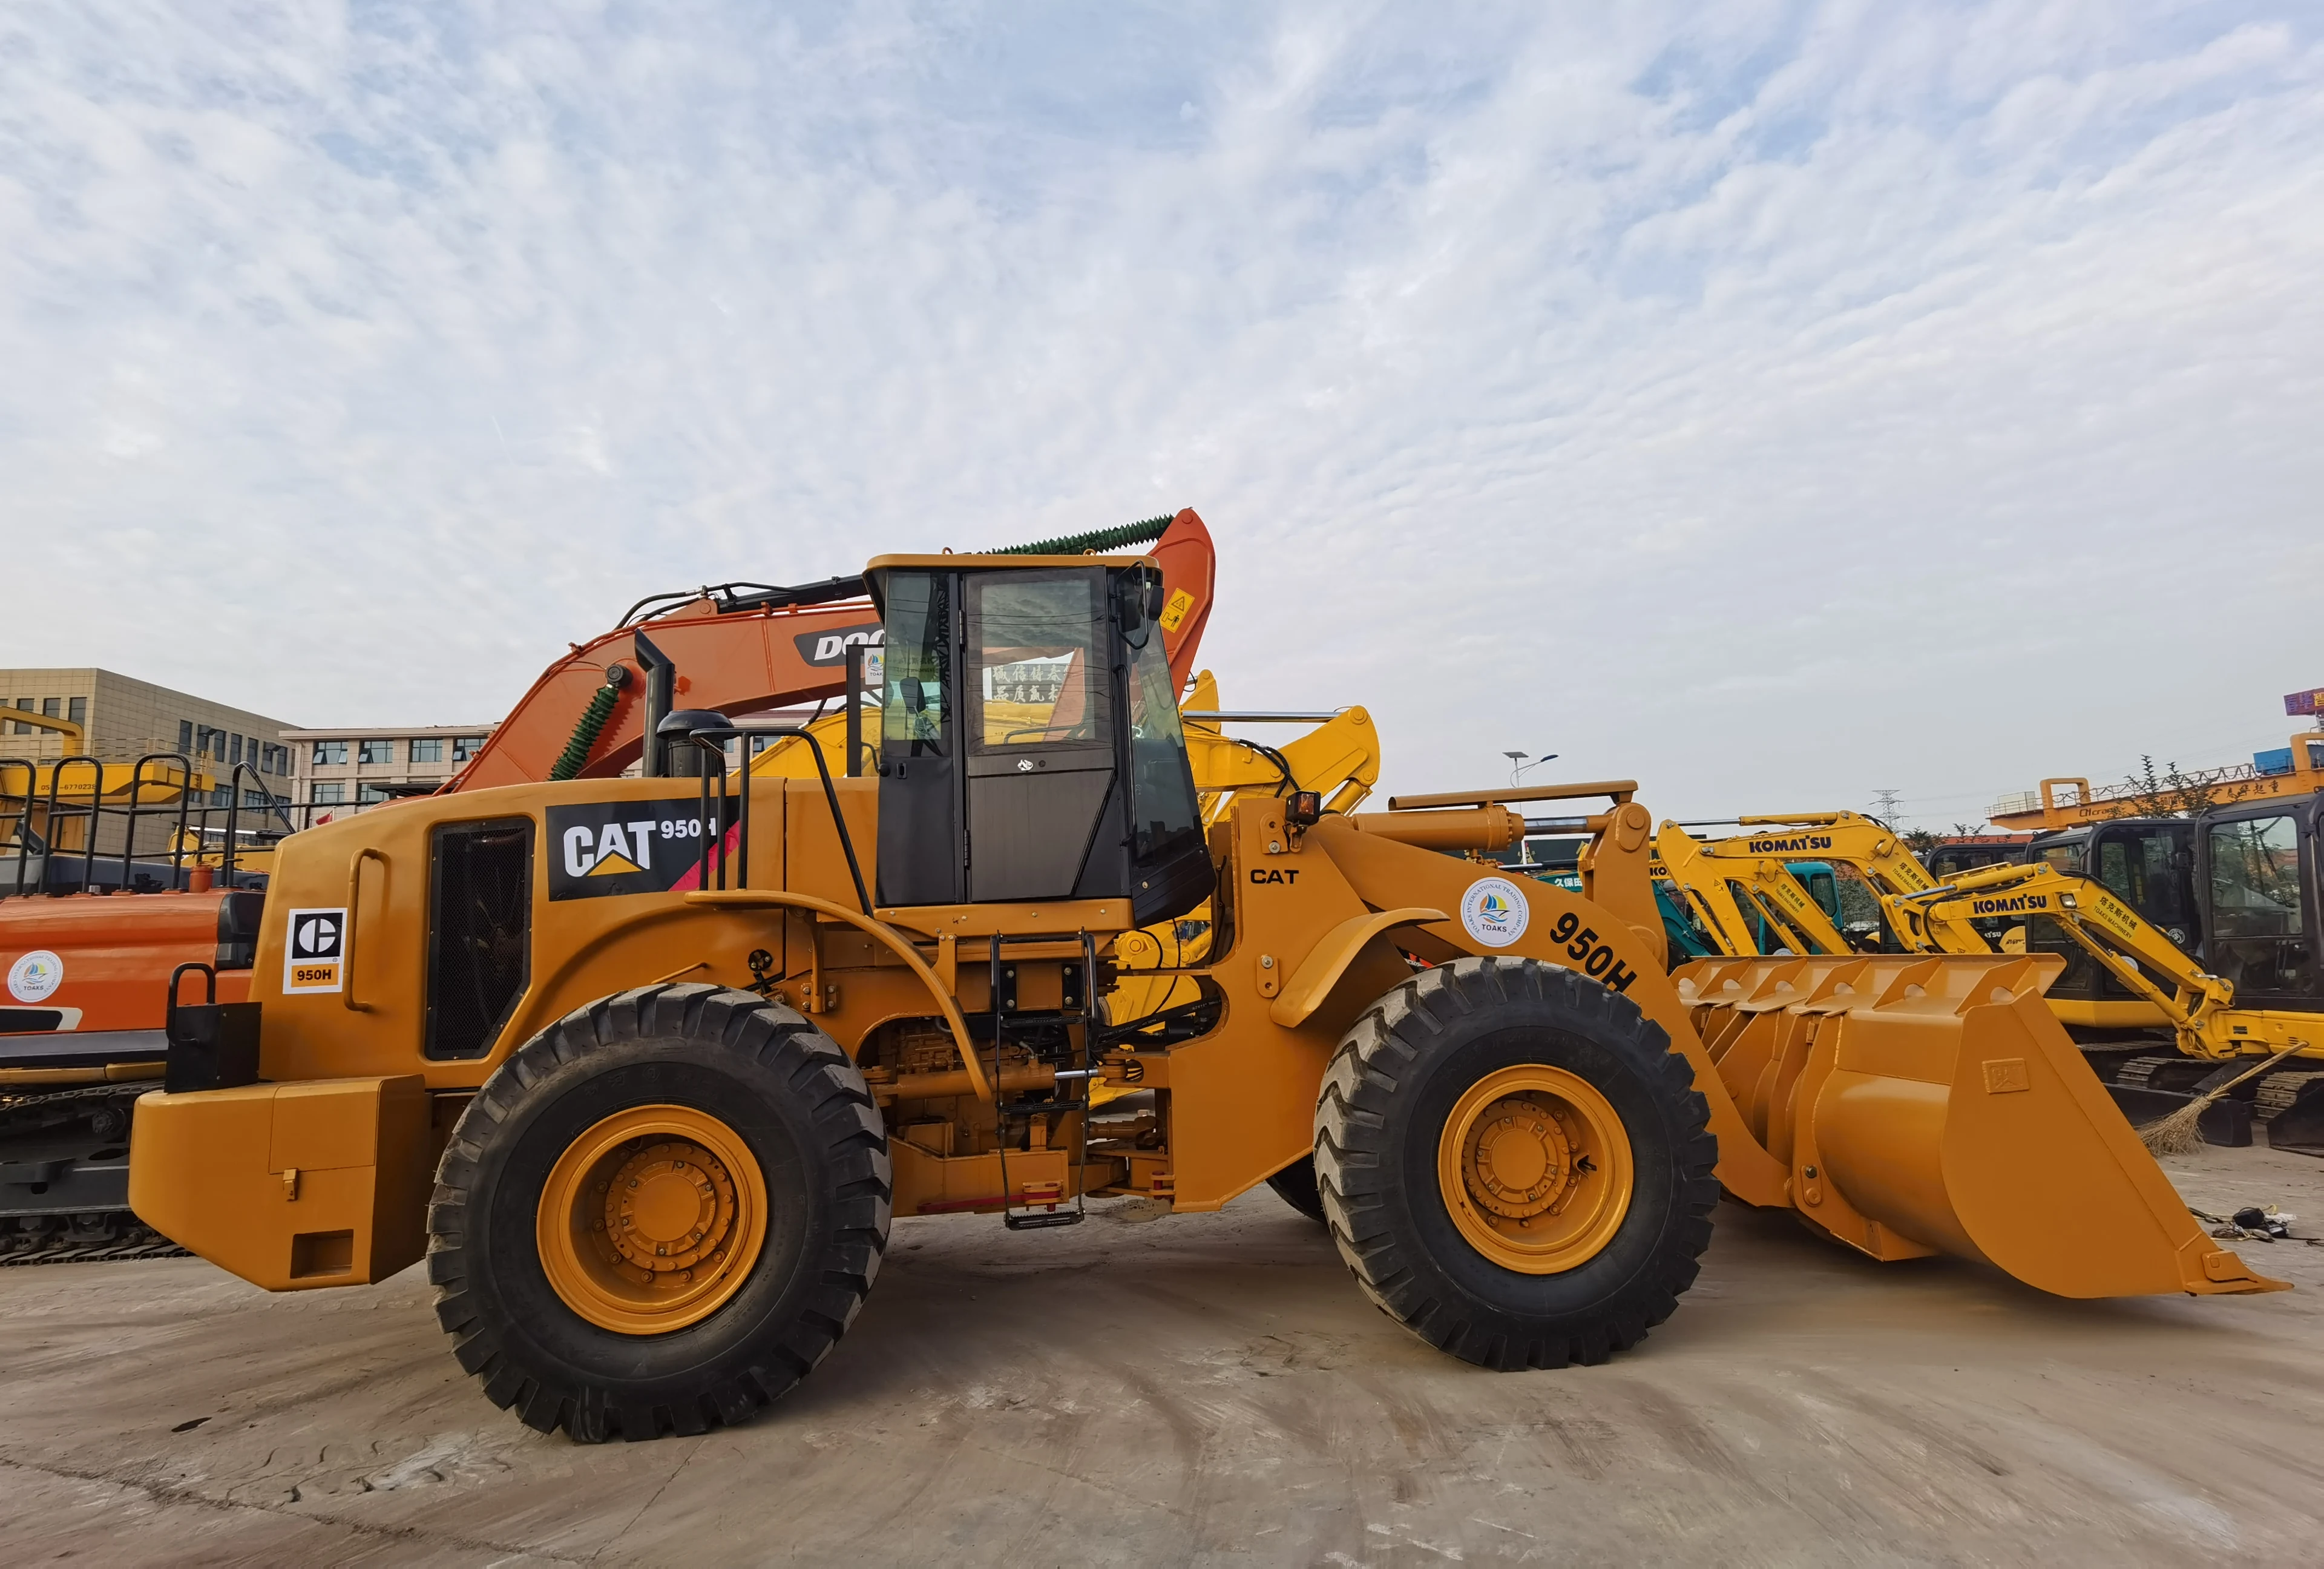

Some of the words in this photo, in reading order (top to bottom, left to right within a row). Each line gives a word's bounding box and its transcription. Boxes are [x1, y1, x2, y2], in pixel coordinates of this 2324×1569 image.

[563, 820, 656, 877] CAT
[1749, 835, 1831, 853] KOMATSU
[1250, 869, 1299, 884] CAT
[1650, 866, 1670, 876] KO
[1892, 868, 1904, 880] TOAKS
[1899, 862, 1929, 890] 塔克斯机械
[1554, 877, 1583, 887] 久保田
[1467, 884, 1502, 913] INTERNATIONAL
[1503, 886, 1523, 909] TRADING
[1973, 893, 2047, 914] KOMATSU
[1508, 910, 1523, 937] COMPANY
[2093, 906, 2108, 920] TOAKS
[2107, 917, 2132, 939] MACHINERY
[2099, 896, 2137, 930] 塔克斯机械
[1467, 914, 1480, 934] TOAKS
[1482, 924, 1508, 933] TOAKS
[1549, 912, 1638, 993] 950H
[297, 969, 332, 981] 950H
